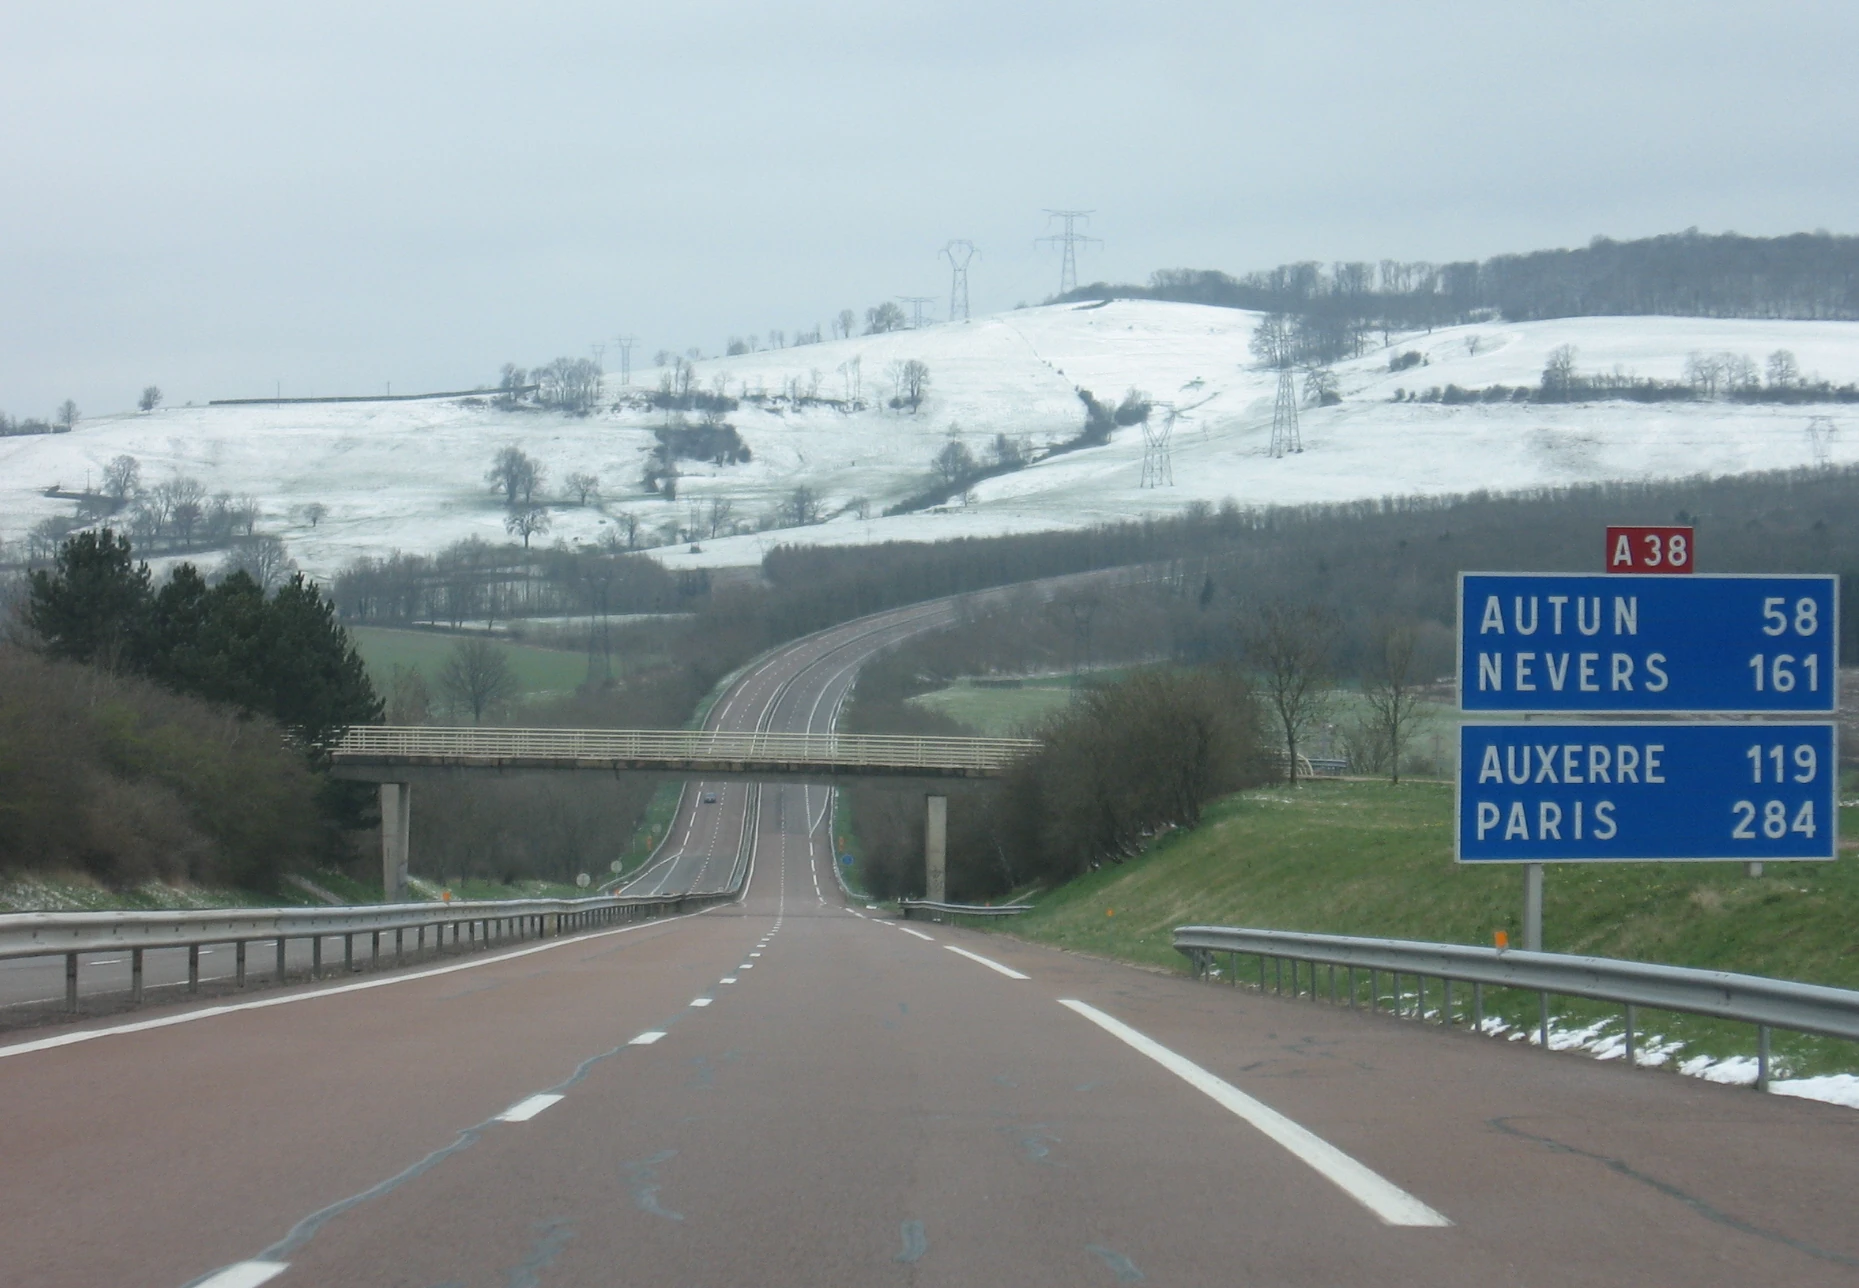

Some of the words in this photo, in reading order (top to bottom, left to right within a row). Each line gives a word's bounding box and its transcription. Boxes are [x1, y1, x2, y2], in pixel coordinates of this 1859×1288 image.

[1613, 534, 1632, 566] A
[1644, 534, 1688, 567] 38
[1480, 596, 1638, 635] AUTUN
[1762, 597, 1818, 637] 58
[1478, 652, 1669, 692] NEVERS
[1749, 653, 1818, 692] 161
[1478, 745, 1666, 785] AUXERRE
[1746, 744, 1817, 784] 119
[1477, 801, 1618, 841] PARIS
[1731, 800, 1817, 840] 284
